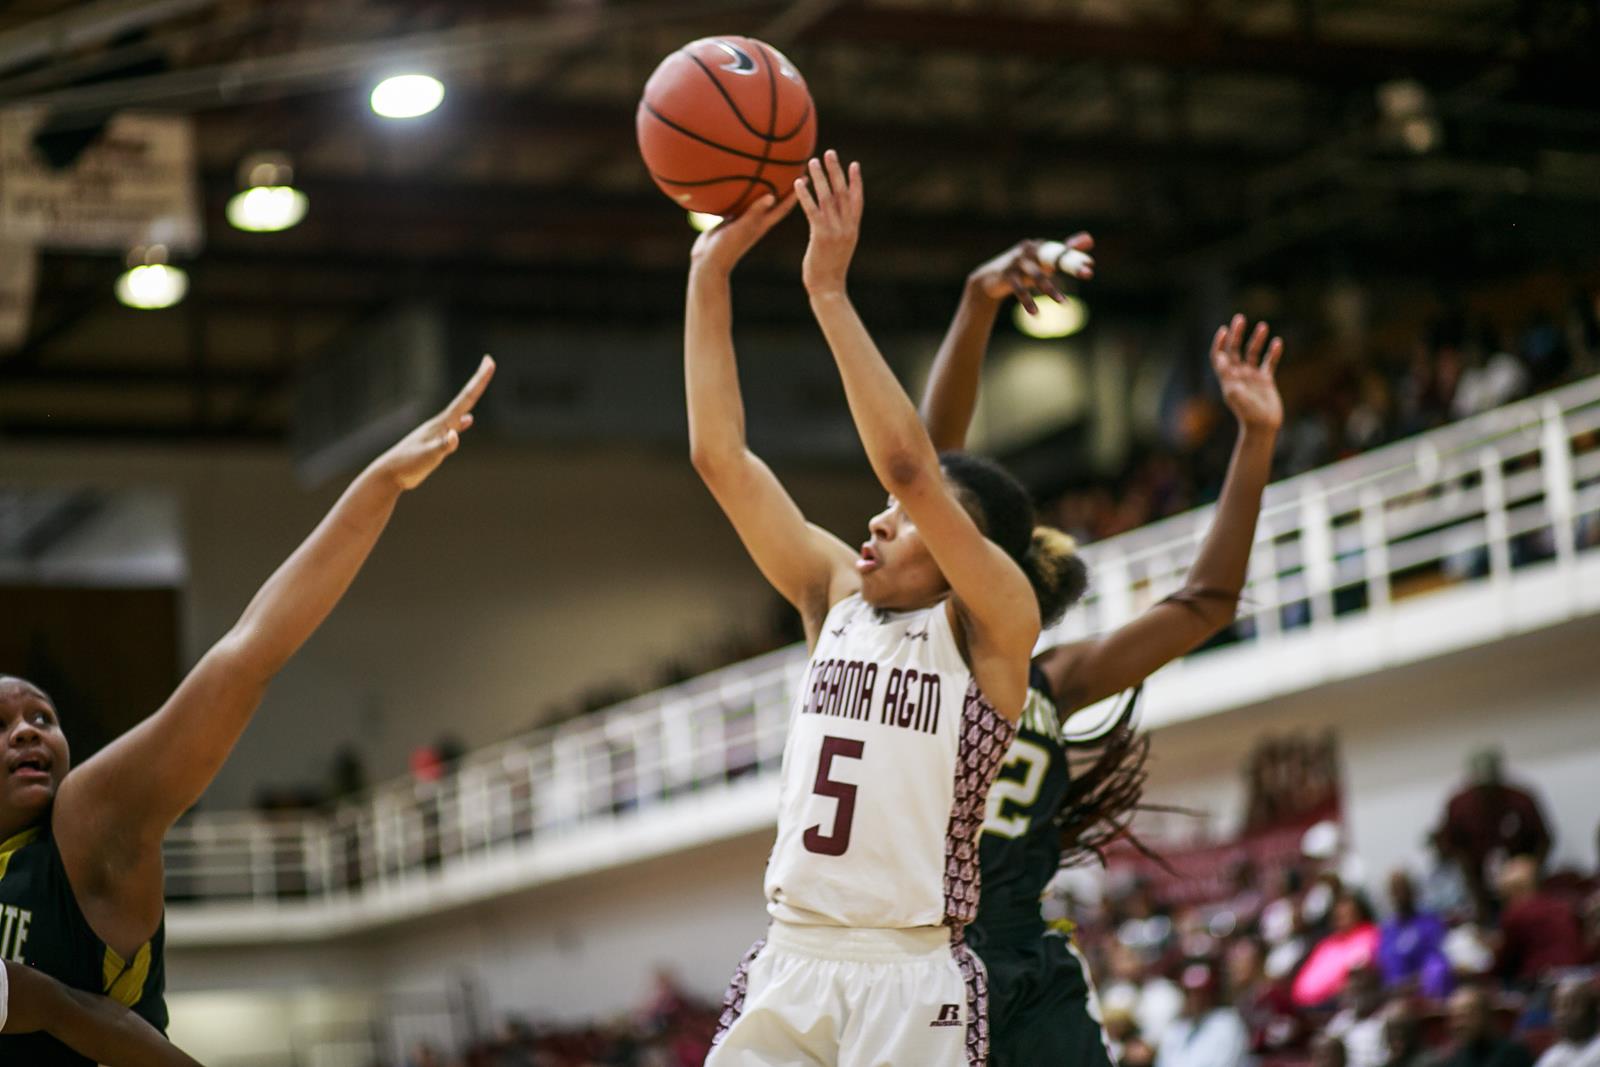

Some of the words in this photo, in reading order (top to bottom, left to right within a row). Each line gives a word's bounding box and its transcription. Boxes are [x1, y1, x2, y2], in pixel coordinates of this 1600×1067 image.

[881, 667, 941, 735] A&M
[803, 735, 865, 857] 5
[0, 903, 32, 965] TE
